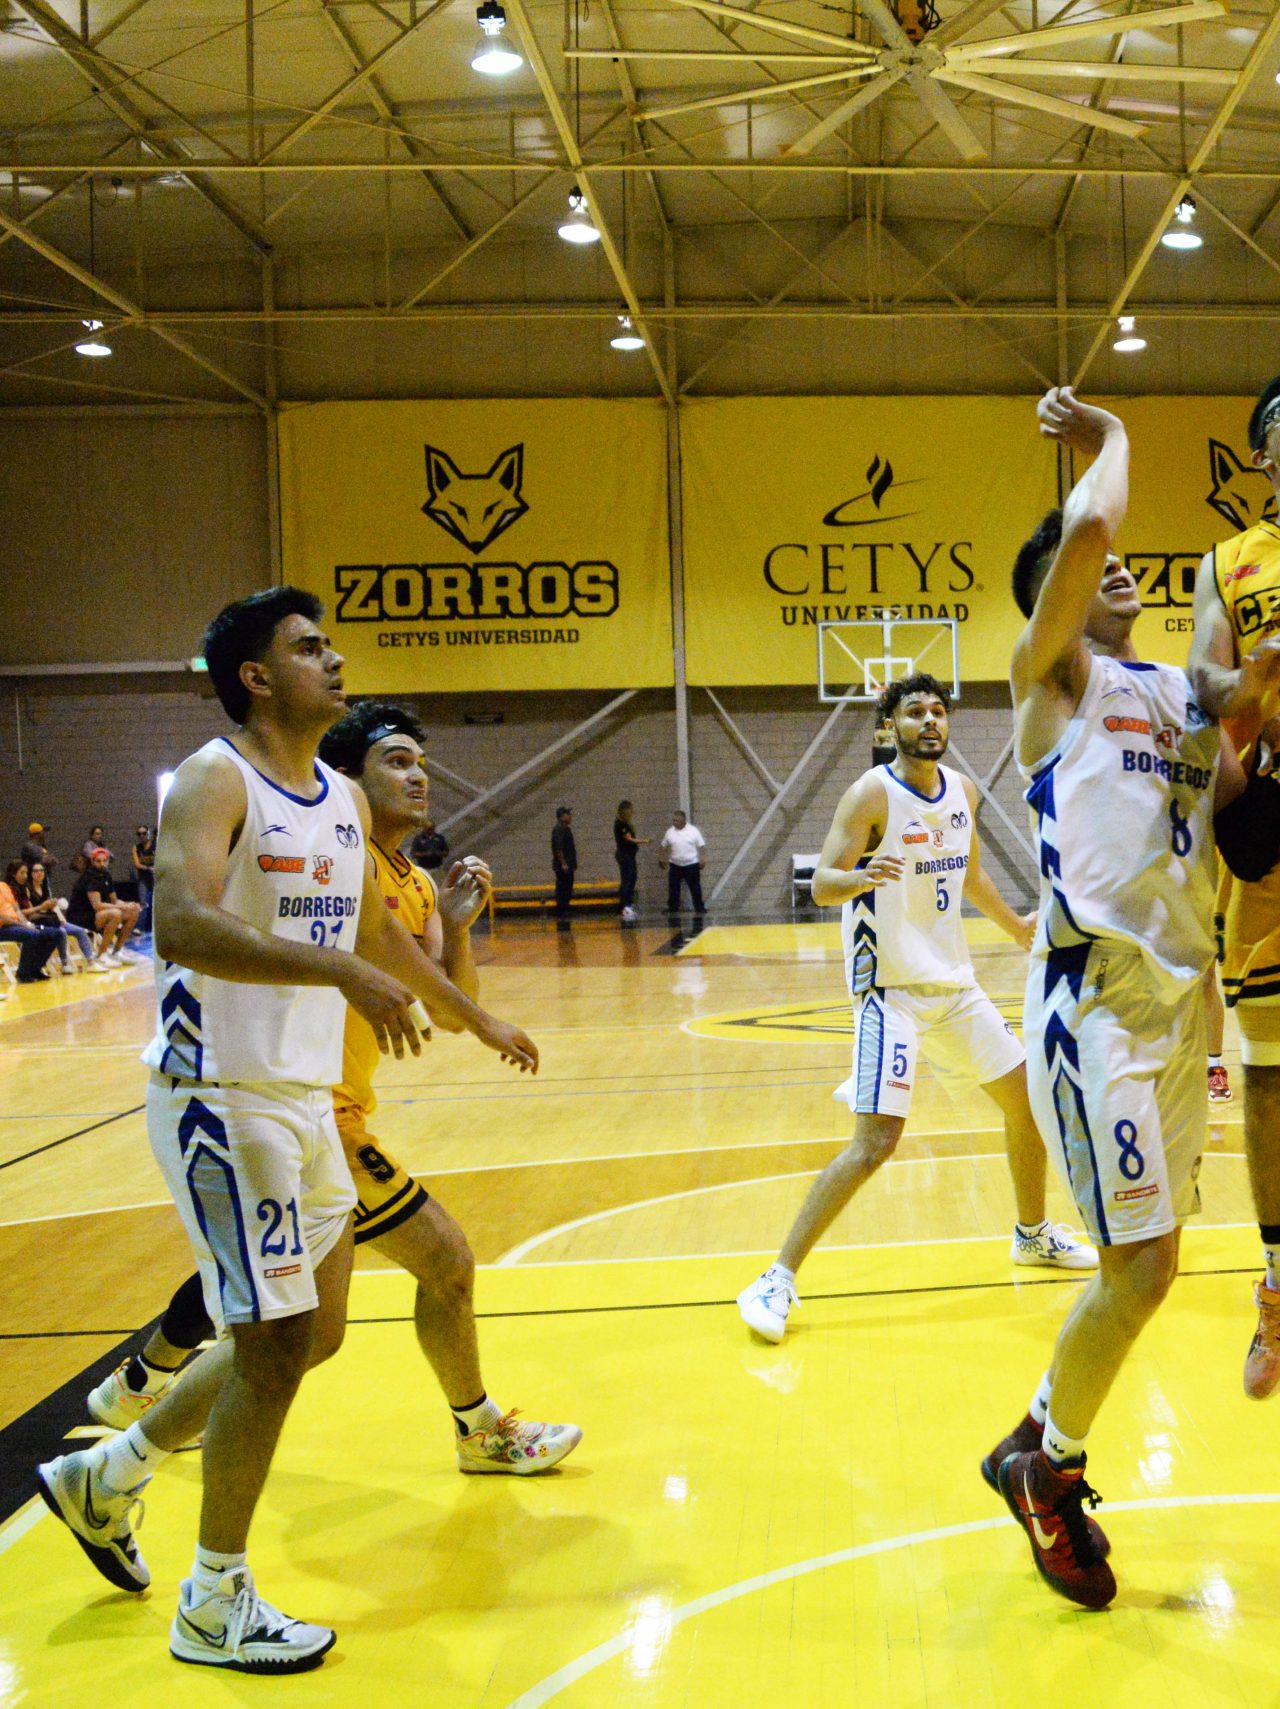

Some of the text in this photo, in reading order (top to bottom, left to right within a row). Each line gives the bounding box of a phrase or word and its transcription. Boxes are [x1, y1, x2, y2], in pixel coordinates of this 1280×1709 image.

[763, 542, 975, 596] CETYS
[335, 561, 619, 623] ZORROS
[378, 629, 579, 648] CETYS UNIVERSIDAD
[1165, 618, 1196, 632] CET
[936, 877, 950, 912] 5
[892, 1042, 908, 1078] 5
[1114, 1119, 1145, 1181] 8
[256, 1196, 304, 1258] 21
